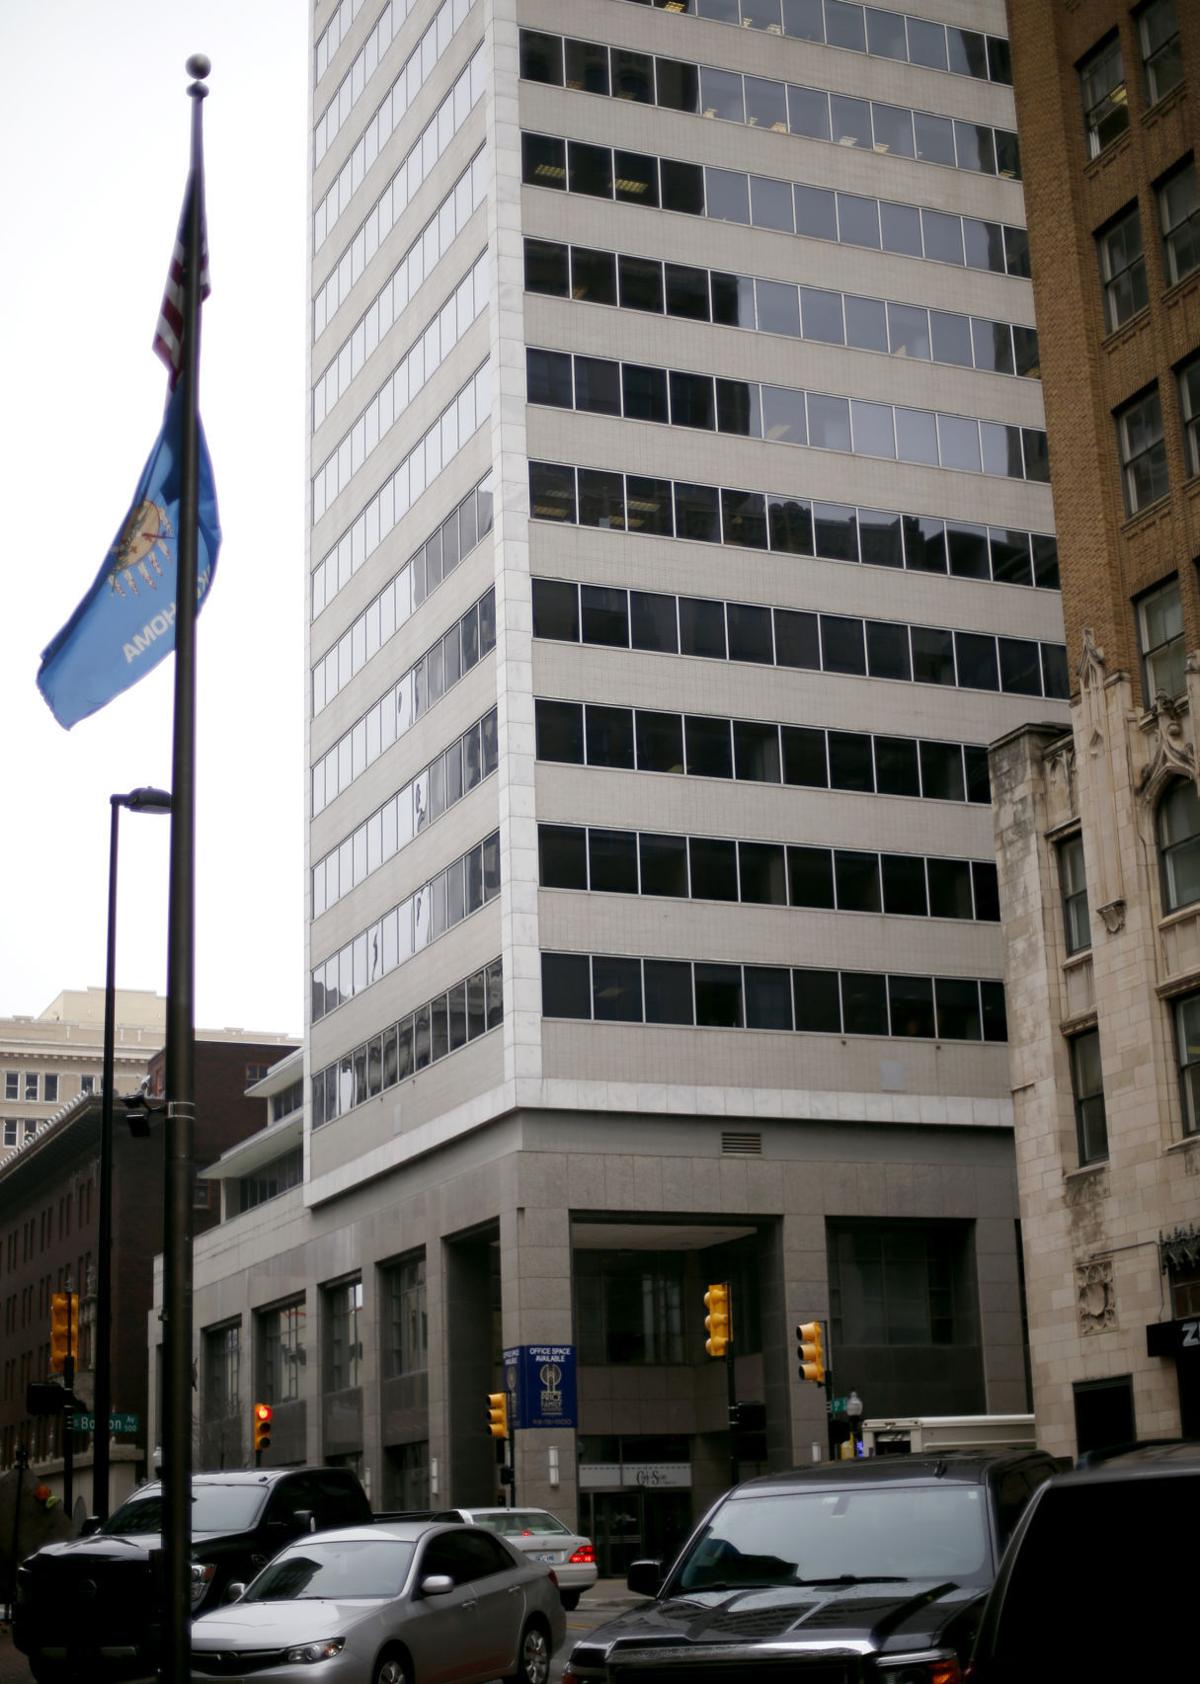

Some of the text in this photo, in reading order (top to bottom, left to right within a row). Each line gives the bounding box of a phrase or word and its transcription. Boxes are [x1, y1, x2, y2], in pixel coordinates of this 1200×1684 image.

[529, 1347, 551, 1355] OFFICE
[552, 1347, 571, 1355] SPACE
[80, 1416, 122, 1431] Boon
